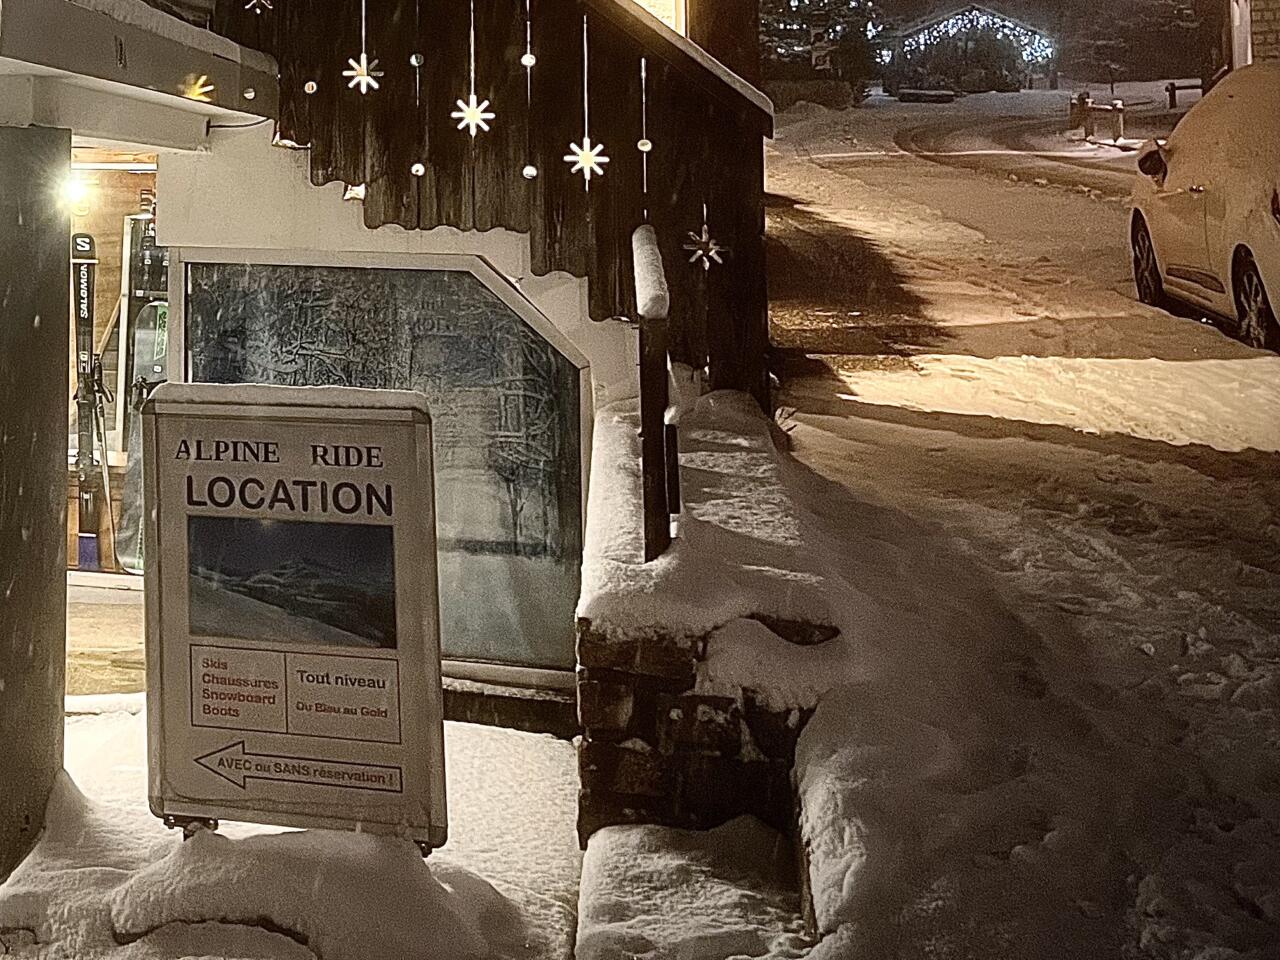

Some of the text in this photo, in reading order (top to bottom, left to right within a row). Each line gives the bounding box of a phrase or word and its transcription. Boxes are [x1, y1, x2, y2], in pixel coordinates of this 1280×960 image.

[80, 264, 89, 319] SALOMON
[175, 439, 384, 468] ALPINE RIDE
[186, 475, 393, 517] LOCATION
[202, 658, 228, 671] Skis
[202, 673, 279, 690] Chaussures
[296, 670, 387, 690] Tout niveau
[202, 689, 277, 705] Snowboard
[202, 704, 241, 718] Boots
[343, 707, 358, 716] au
[360, 706, 389, 718] Gold
[217, 757, 252, 772] AVEC
[255, 763, 271, 772] ou
[274, 761, 311, 777] SANS
